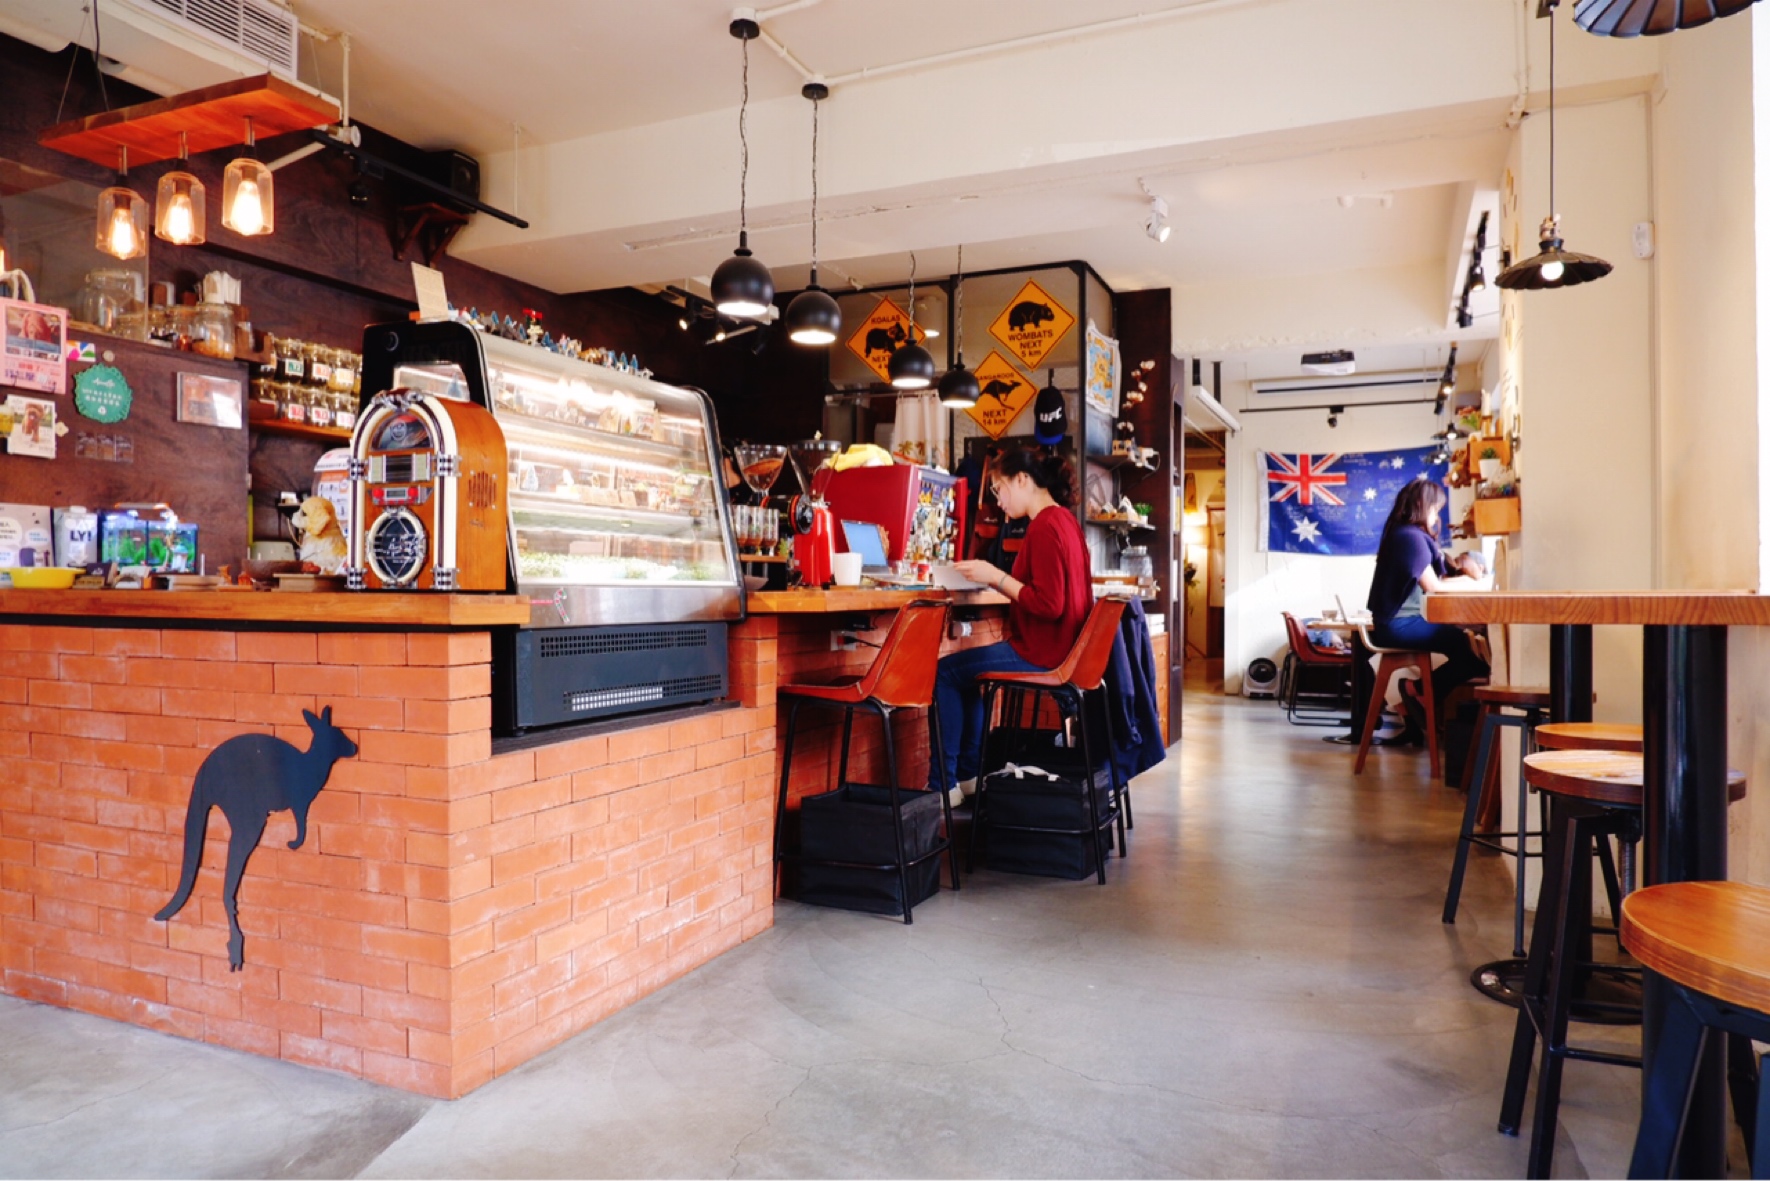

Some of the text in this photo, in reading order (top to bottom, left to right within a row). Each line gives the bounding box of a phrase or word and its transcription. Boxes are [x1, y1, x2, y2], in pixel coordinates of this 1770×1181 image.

[871, 314, 900, 324] KOALAS
[1008, 328, 1053, 342] WOMBATS
[1020, 340, 1043, 350] NEXT
[976, 372, 1015, 380] ANGAROOS
[982, 408, 1006, 418] NEXT
[1040, 406, 1062, 423] UFC
[70, 530, 92, 542] LY!
